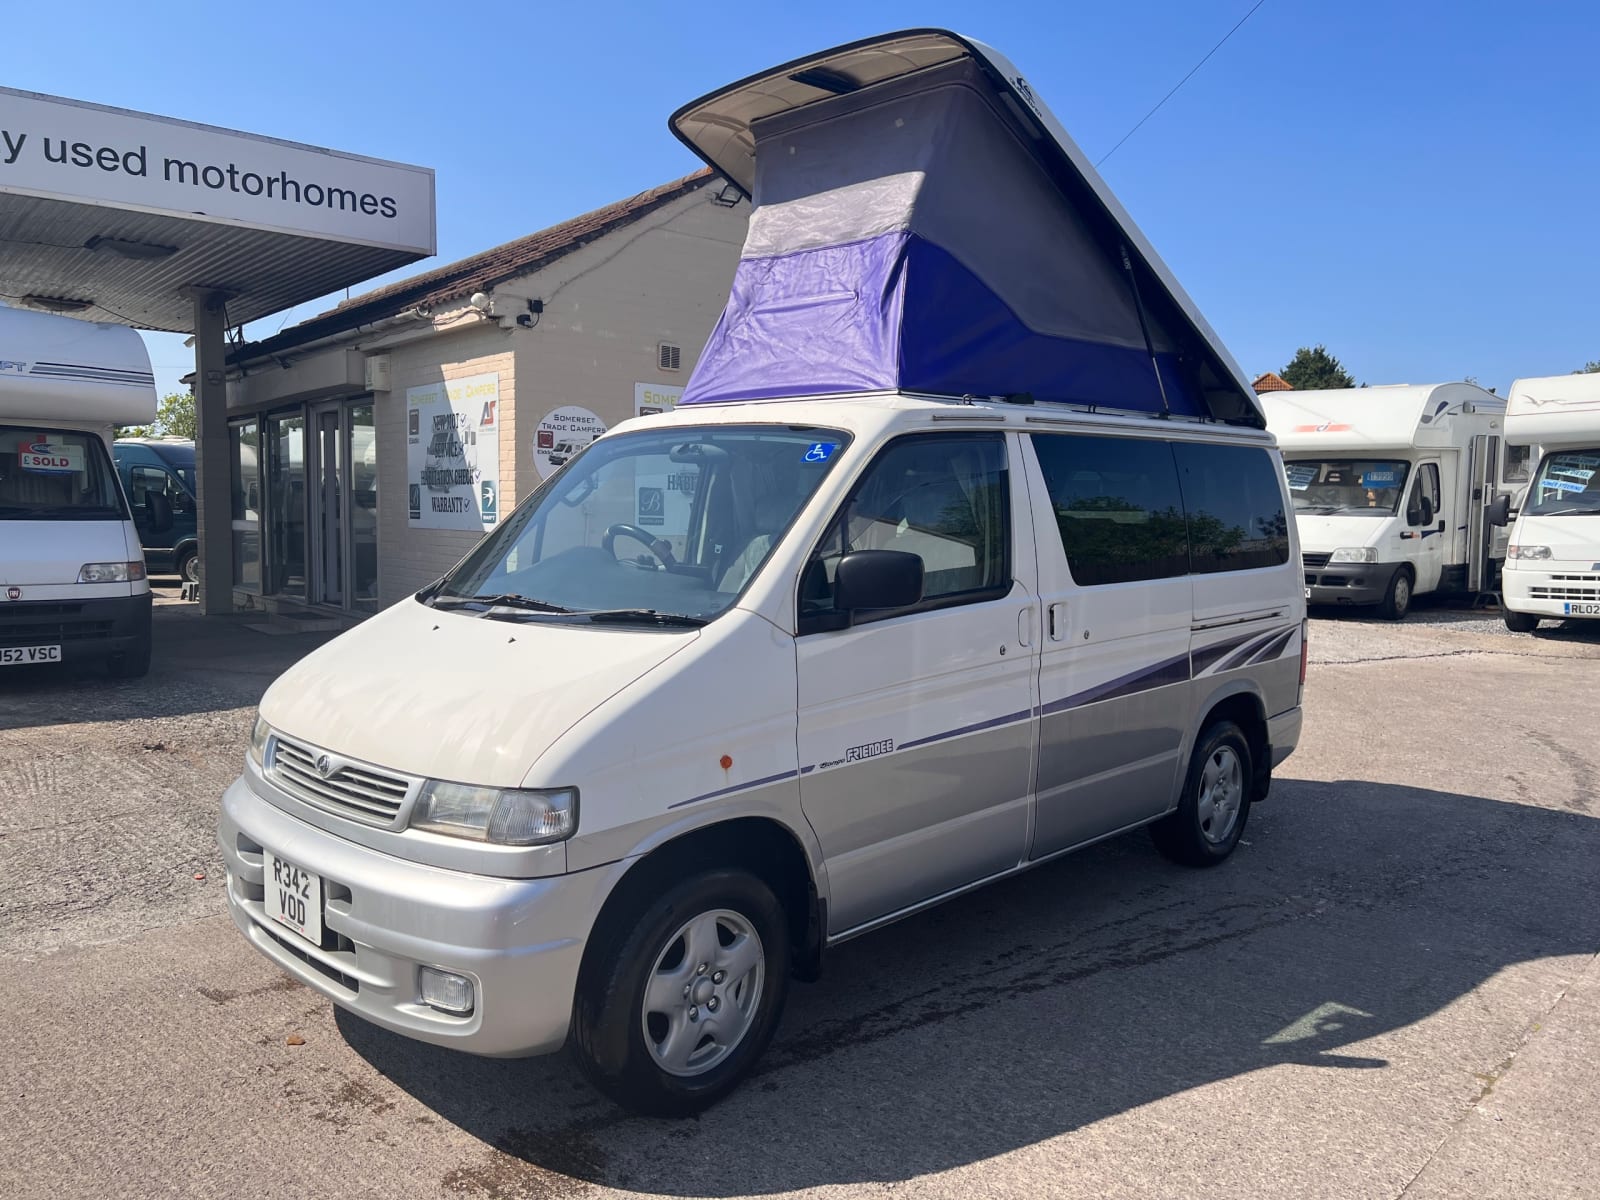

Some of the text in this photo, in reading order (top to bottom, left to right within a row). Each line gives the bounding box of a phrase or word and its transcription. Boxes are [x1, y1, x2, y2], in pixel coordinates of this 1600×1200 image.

[43, 138, 147, 177] used
[164, 157, 398, 219] motorhomes
[643, 391, 679, 406] SOME
[553, 414, 596, 424] SOMERSET
[541, 422, 606, 433] TRADE CAMPERS
[33, 456, 70, 467] SOLD
[454, 468, 474, 485] CHECK
[431, 496, 464, 513] WARRANTY
[1571, 604, 1600, 615] RL02
[28, 647, 58, 661] VSC
[846, 738, 894, 763] FRIENDEE
[272, 856, 310, 900] R342
[279, 887, 306, 926] VOD
